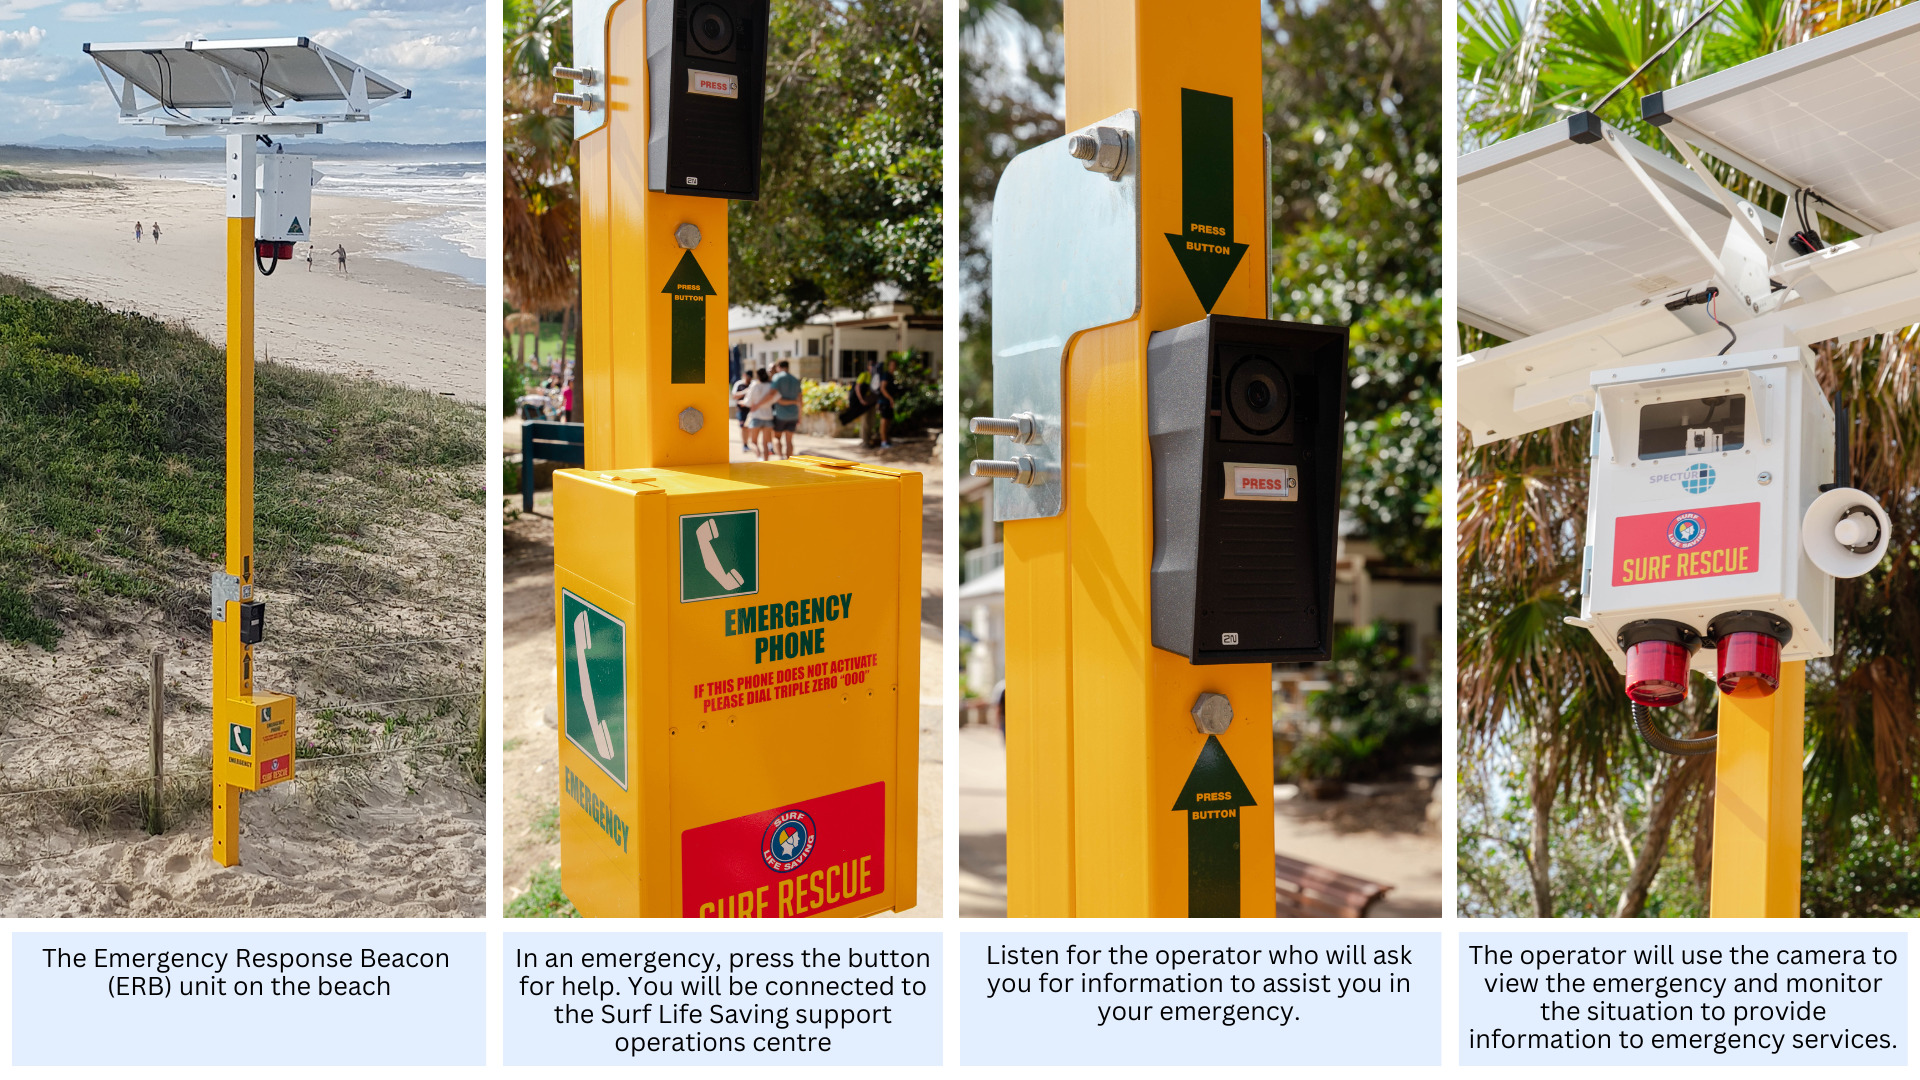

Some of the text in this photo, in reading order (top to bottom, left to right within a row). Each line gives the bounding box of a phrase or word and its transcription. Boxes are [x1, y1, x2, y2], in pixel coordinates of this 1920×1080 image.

[700, 80, 728, 91] PRESS
[1190, 223, 1226, 236] PRESS
[1186, 241, 1230, 255] BUTTON
[674, 294, 704, 302] BUTTON
[1242, 477, 1282, 490] PRESS
[1649, 470, 1699, 484] SPECTUR
[1676, 513, 1700, 522] SURF
[1668, 528, 1706, 549] LIFE SAVING
[1622, 547, 1749, 583] SURF RESCUE
[725, 593, 853, 637] EMERGENCY
[755, 628, 825, 664] PHONE
[694, 653, 878, 699] IF THIS PHONE DOES NOT ACTIVATE
[703, 693, 745, 714] PLEASE
[747, 688, 772, 706] DIAL
[774, 680, 810, 700] TRIPLE
[812, 675, 838, 692] ZERO
[1196, 791, 1232, 802] PRESS
[565, 766, 629, 854] EMERGENCY
[1192, 809, 1237, 820] BUTTON
[773, 812, 805, 828] SURF
[763, 834, 815, 871] LIFE SAVING
[778, 855, 872, 917] RESCUE
